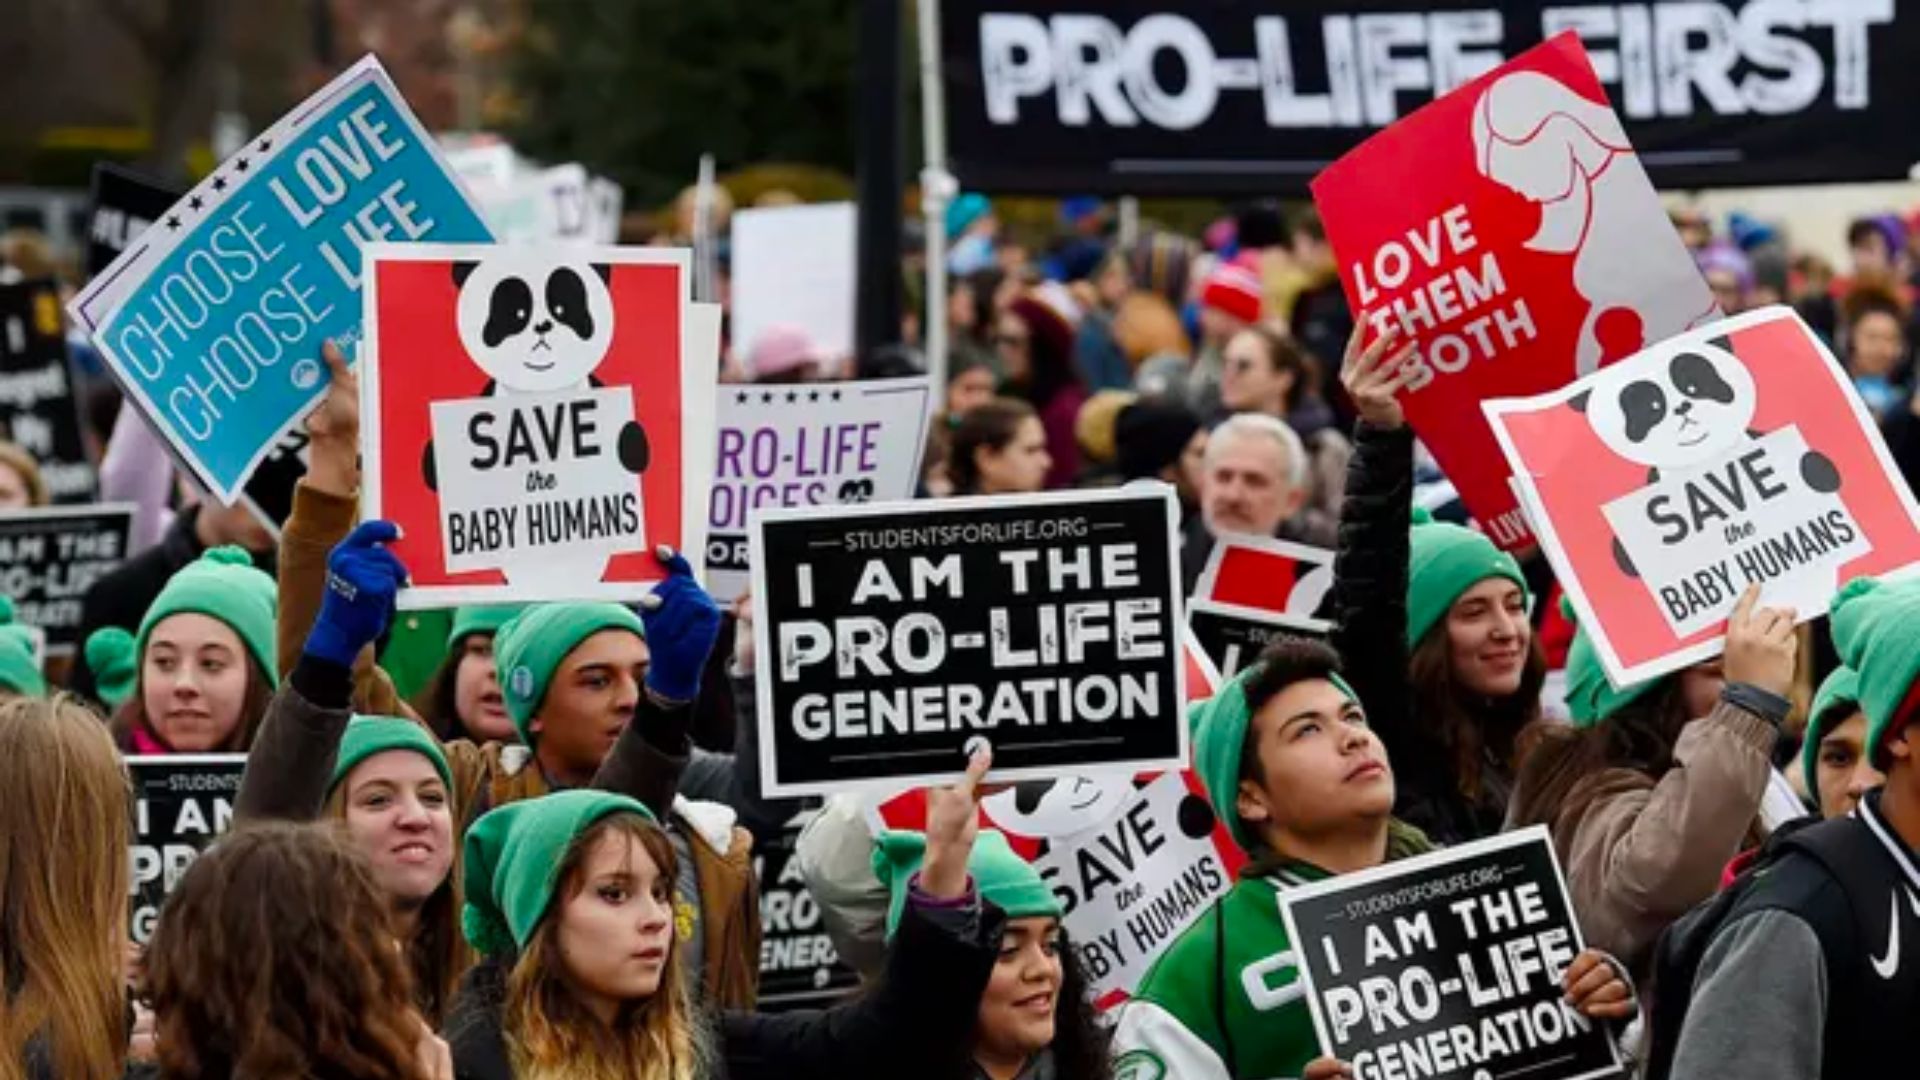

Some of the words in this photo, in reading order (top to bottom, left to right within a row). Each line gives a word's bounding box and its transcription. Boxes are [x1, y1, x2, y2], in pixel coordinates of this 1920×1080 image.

[979, 11, 1503, 130] PRO-LIFE
[119, 200, 286, 381] CHOOSE
[268, 98, 407, 229] LOVE
[1353, 203, 1478, 305] LOVE
[1368, 251, 1507, 338] THEM
[169, 262, 336, 442] CHOOSE
[1400, 297, 1538, 394] BOTH
[468, 399, 601, 470] SAVE
[716, 420, 882, 479] RO-LIFE
[449, 504, 518, 555] BABY
[527, 492, 638, 546] HUMANS
[525, 469, 557, 493] the
[1645, 447, 1788, 545] SAVE
[843, 517, 1089, 551] STUDENTSFORLIFE.ORG
[1659, 559, 1737, 623] BABY
[1734, 509, 1856, 585] HUMANS
[1722, 519, 1756, 546] the
[797, 563, 814, 608] I
[851, 553, 965, 605] AM
[999, 543, 1140, 594] THE
[778, 597, 1166, 682] PRO-LIFE
[791, 671, 1160, 741] GENERATION
[136, 798, 149, 835] I
[1040, 798, 1166, 916] SAVE
[1114, 882, 1146, 912] the
[1126, 856, 1223, 955] HUMANS
[1322, 935, 1342, 976] I
[1364, 911, 1438, 967] AM
[1450, 882, 1549, 940] THE
[1345, 864, 1503, 921] STUDENTSFORLIFE.ORG
[1323, 926, 1574, 1044] PRO-LIFE
[1352, 996, 1592, 1080] GENERATION
